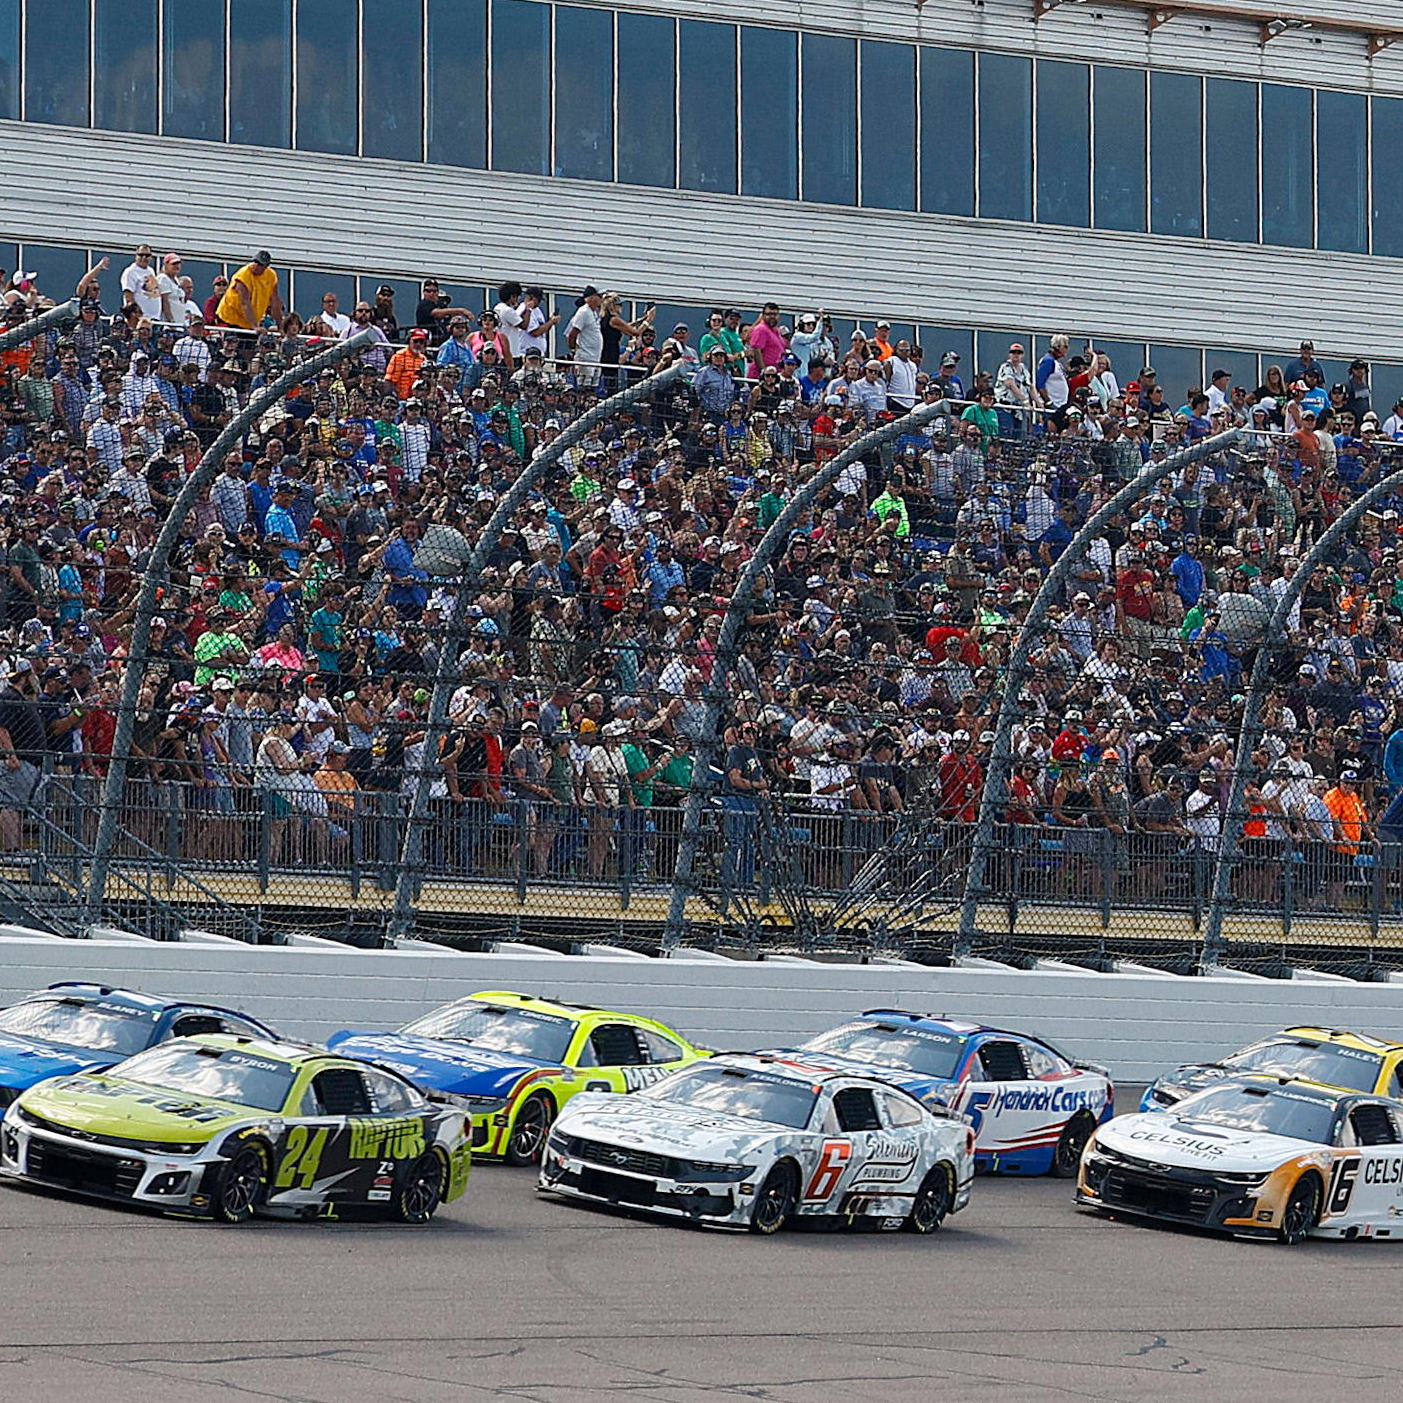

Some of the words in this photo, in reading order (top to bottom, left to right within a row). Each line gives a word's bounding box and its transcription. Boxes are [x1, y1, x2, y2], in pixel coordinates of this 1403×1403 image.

[98, 1002, 146, 1016] BLANEY
[902, 1028, 952, 1044] LARSON
[229, 1055, 279, 1072] BYRON
[1338, 1048, 1376, 1063] HALEY
[349, 1118, 426, 1159] RAPTOR
[1130, 1131, 1227, 1156] CELSIUS
[275, 1125, 329, 1188] 24
[805, 1139, 852, 1204] 6
[863, 1167, 901, 1179] PLUMBING
[1325, 1156, 1361, 1216] 16
